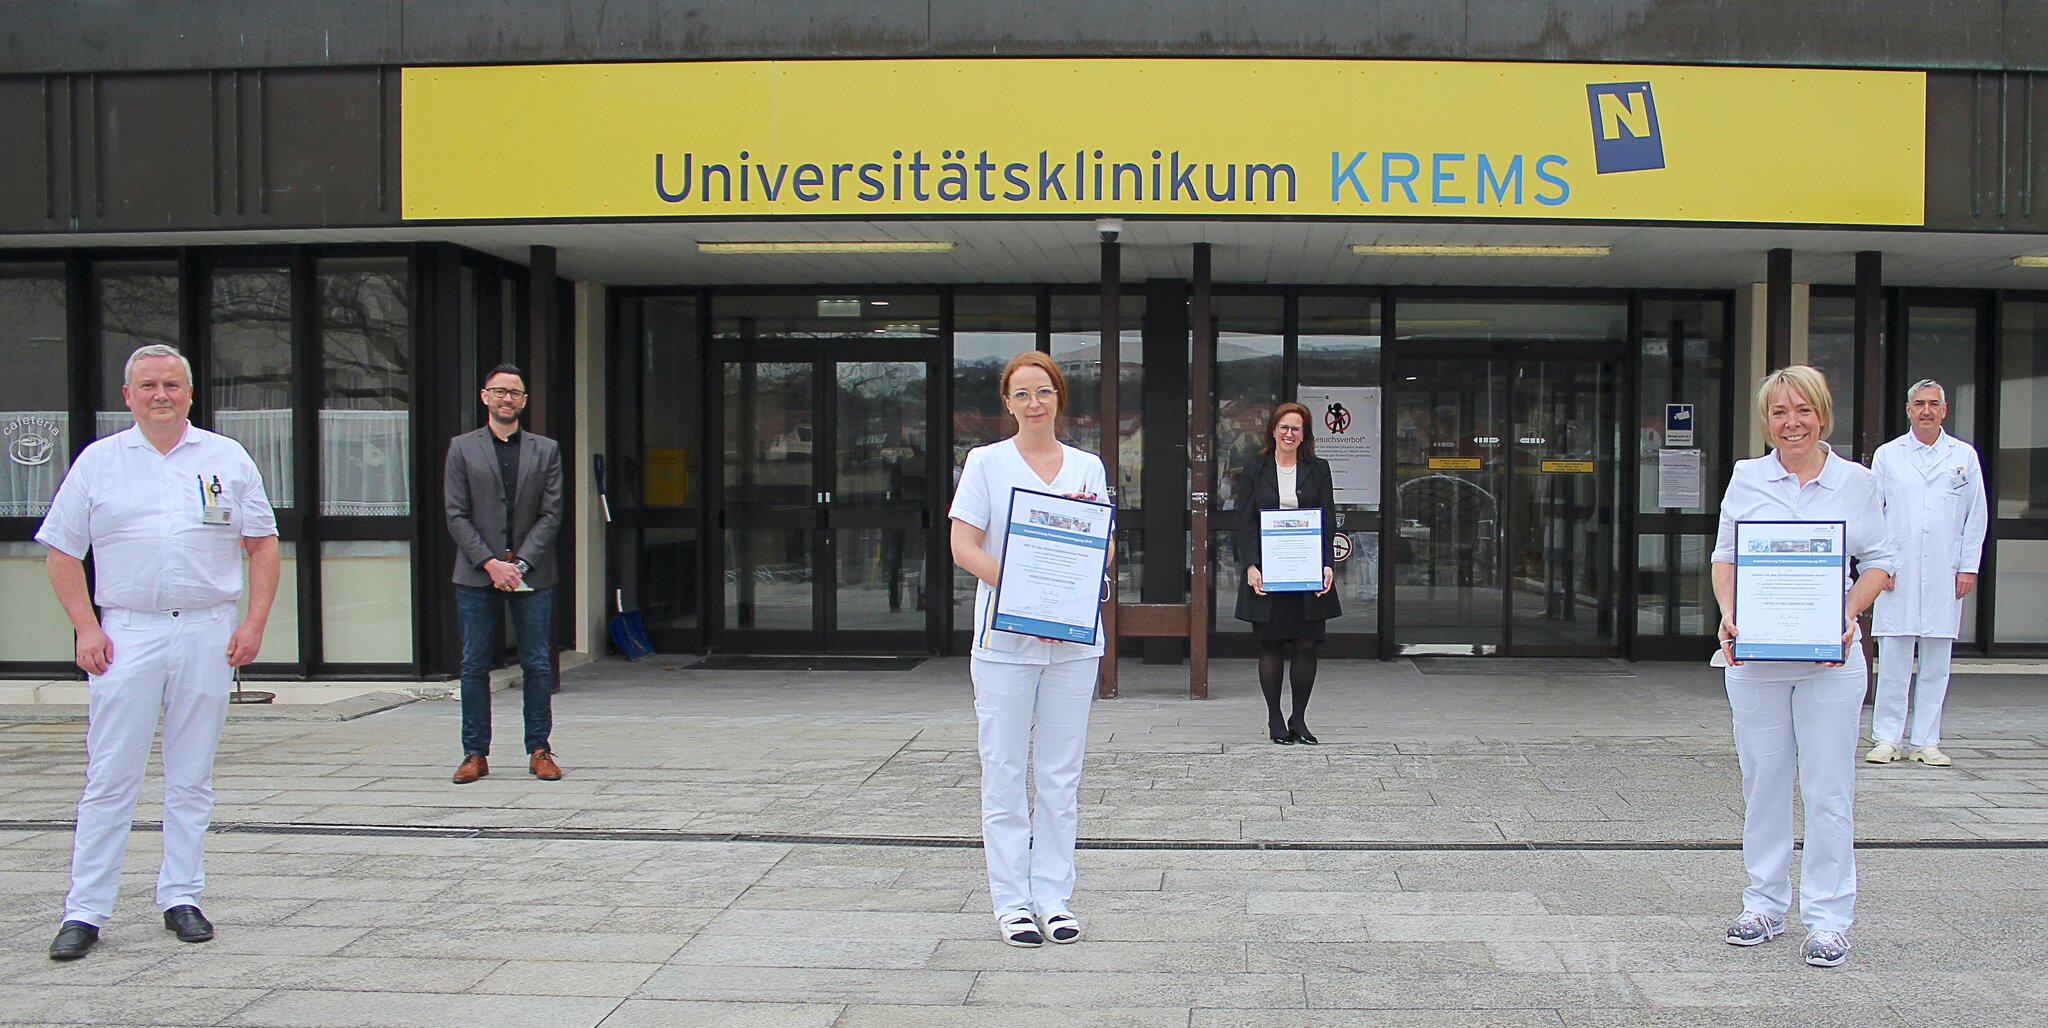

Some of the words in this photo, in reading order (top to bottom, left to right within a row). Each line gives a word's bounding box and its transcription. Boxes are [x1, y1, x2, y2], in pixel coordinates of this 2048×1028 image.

[1598, 92, 1651, 140] N
[655, 149, 1296, 203] Universitätsklinikum
[1331, 151, 1571, 207] KREMS
[3, 416, 60, 436] cafeteria
